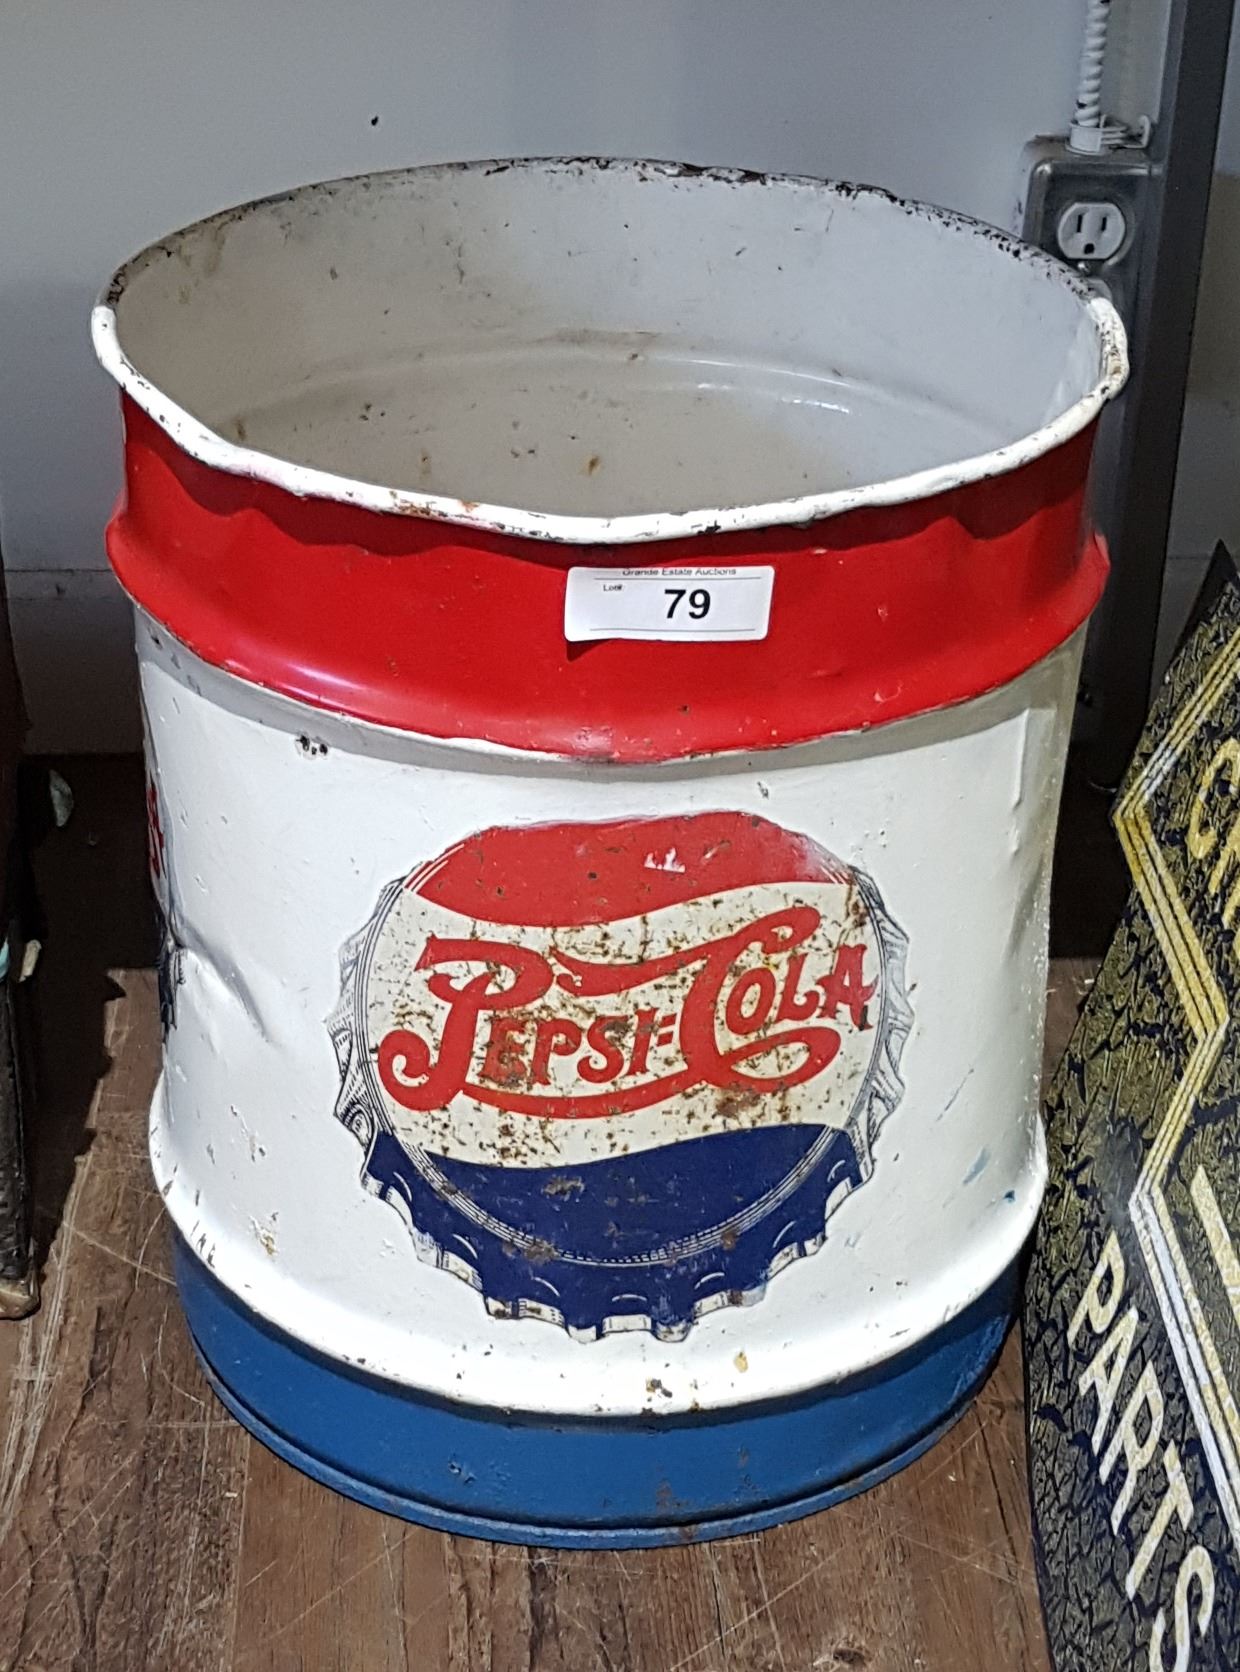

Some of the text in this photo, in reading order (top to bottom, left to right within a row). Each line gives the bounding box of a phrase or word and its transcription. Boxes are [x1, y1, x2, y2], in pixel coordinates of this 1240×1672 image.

[622, 568, 737, 576] Grande Estate Auctions
[664, 588, 711, 619] 79
[1067, 1230, 1215, 1672] PARTS
